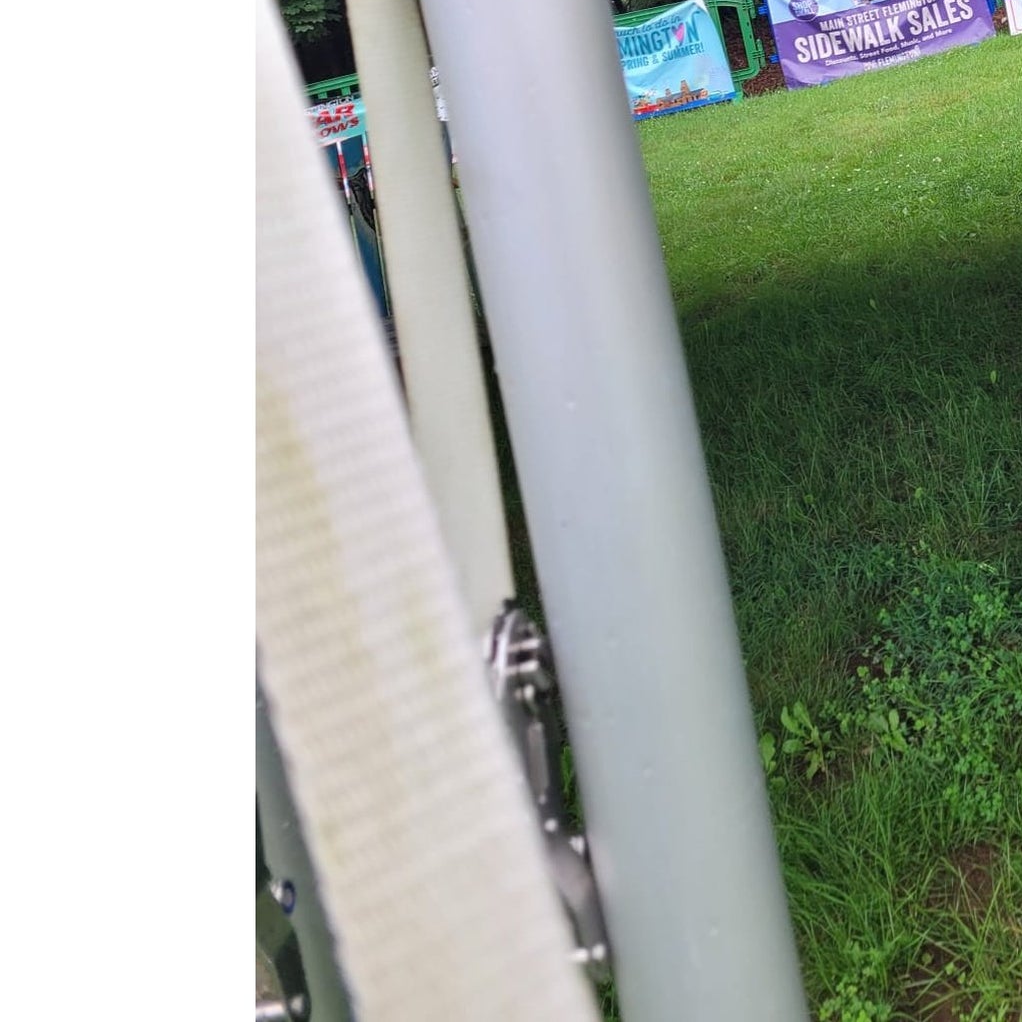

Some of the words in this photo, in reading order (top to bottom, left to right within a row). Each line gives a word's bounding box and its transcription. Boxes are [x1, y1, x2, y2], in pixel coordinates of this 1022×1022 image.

[820, 19, 845, 32] MAIN
[847, 8, 880, 26] STREET
[616, 10, 701, 60] MINGTON
[794, 16, 905, 63] SIDEWALK
[620, 56, 650, 71] PRING
[661, 42, 705, 62] SUMMER!
[320, 116, 359, 138] OWS
